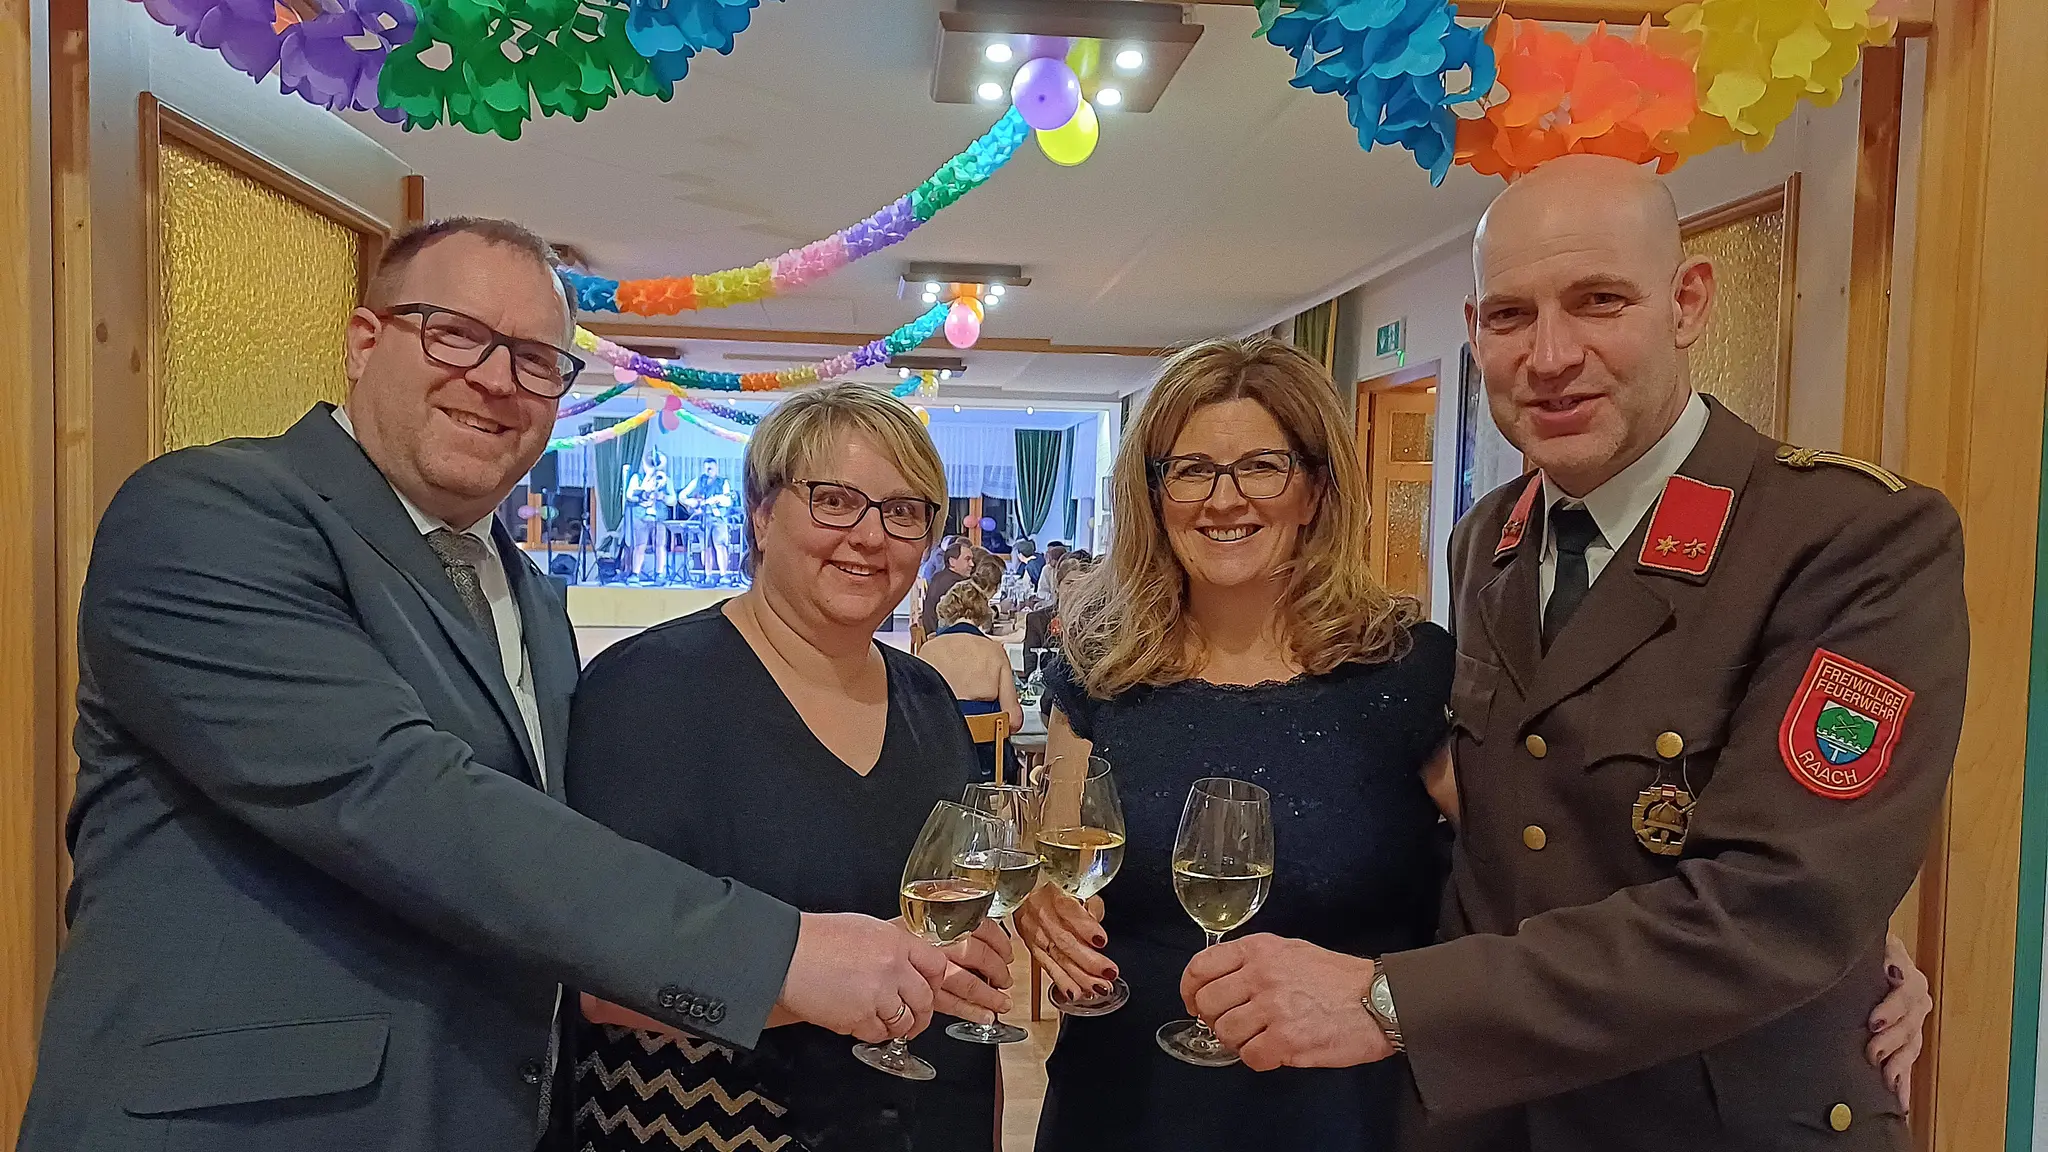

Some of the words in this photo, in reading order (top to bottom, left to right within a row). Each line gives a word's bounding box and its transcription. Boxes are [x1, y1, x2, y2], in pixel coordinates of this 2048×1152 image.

[1815, 678, 1895, 722] FEUERWEHR
[1821, 665, 1901, 710] FREIWILLIGE
[1799, 750, 1858, 785] RAACH
